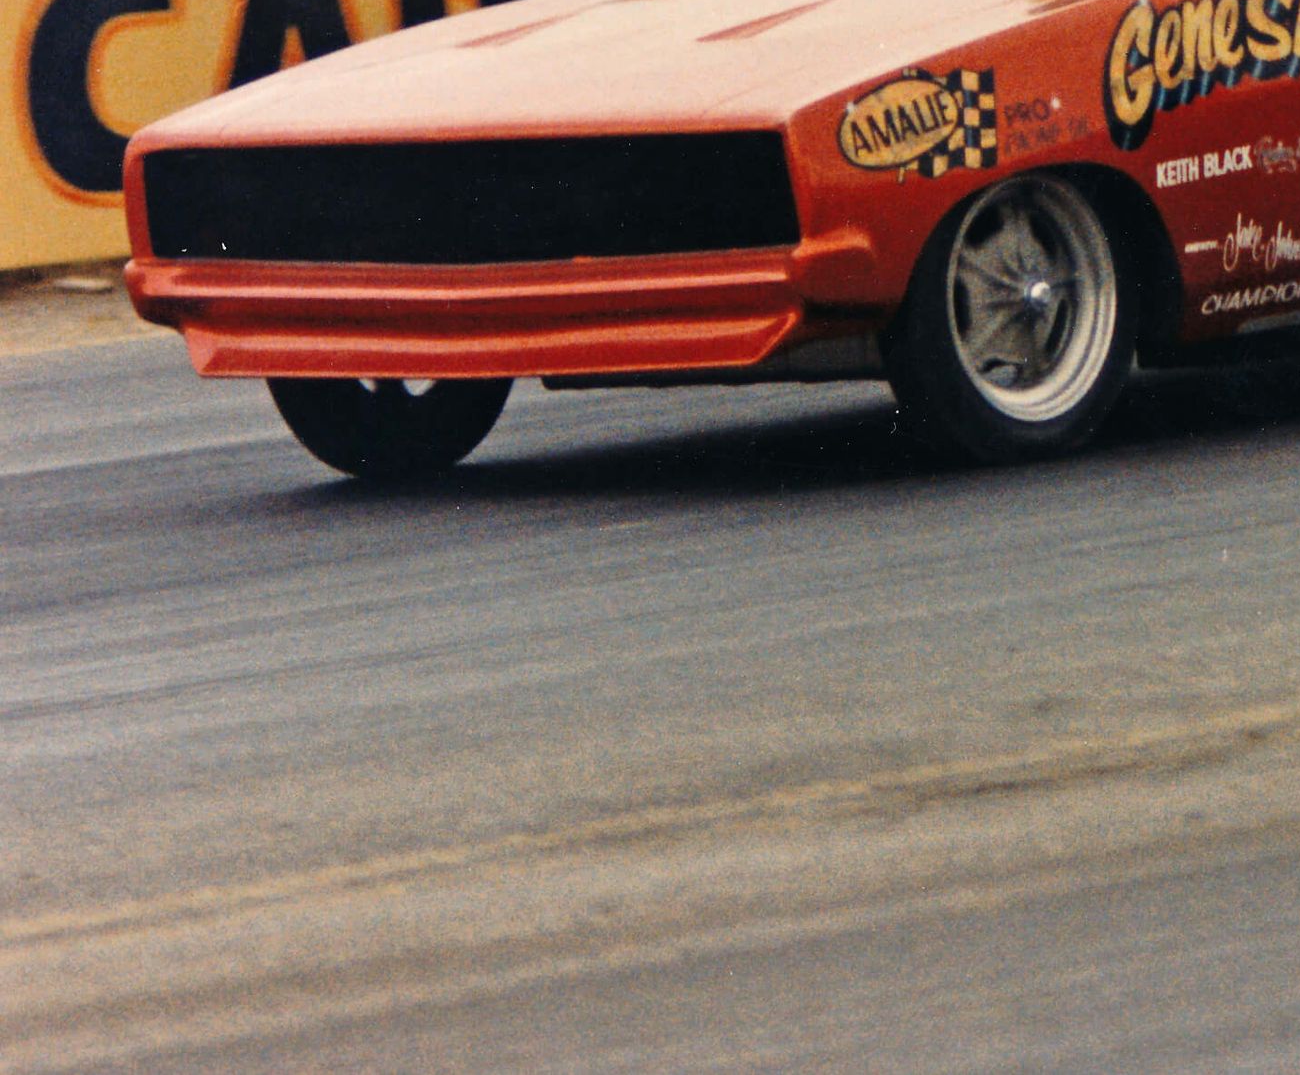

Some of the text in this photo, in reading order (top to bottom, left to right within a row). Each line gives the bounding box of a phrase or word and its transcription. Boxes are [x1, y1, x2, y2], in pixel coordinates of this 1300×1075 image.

[850, 89, 955, 157] AMALIE
[1156, 157, 1200, 188] KEITH
[1203, 145, 1253, 178] BLACK
